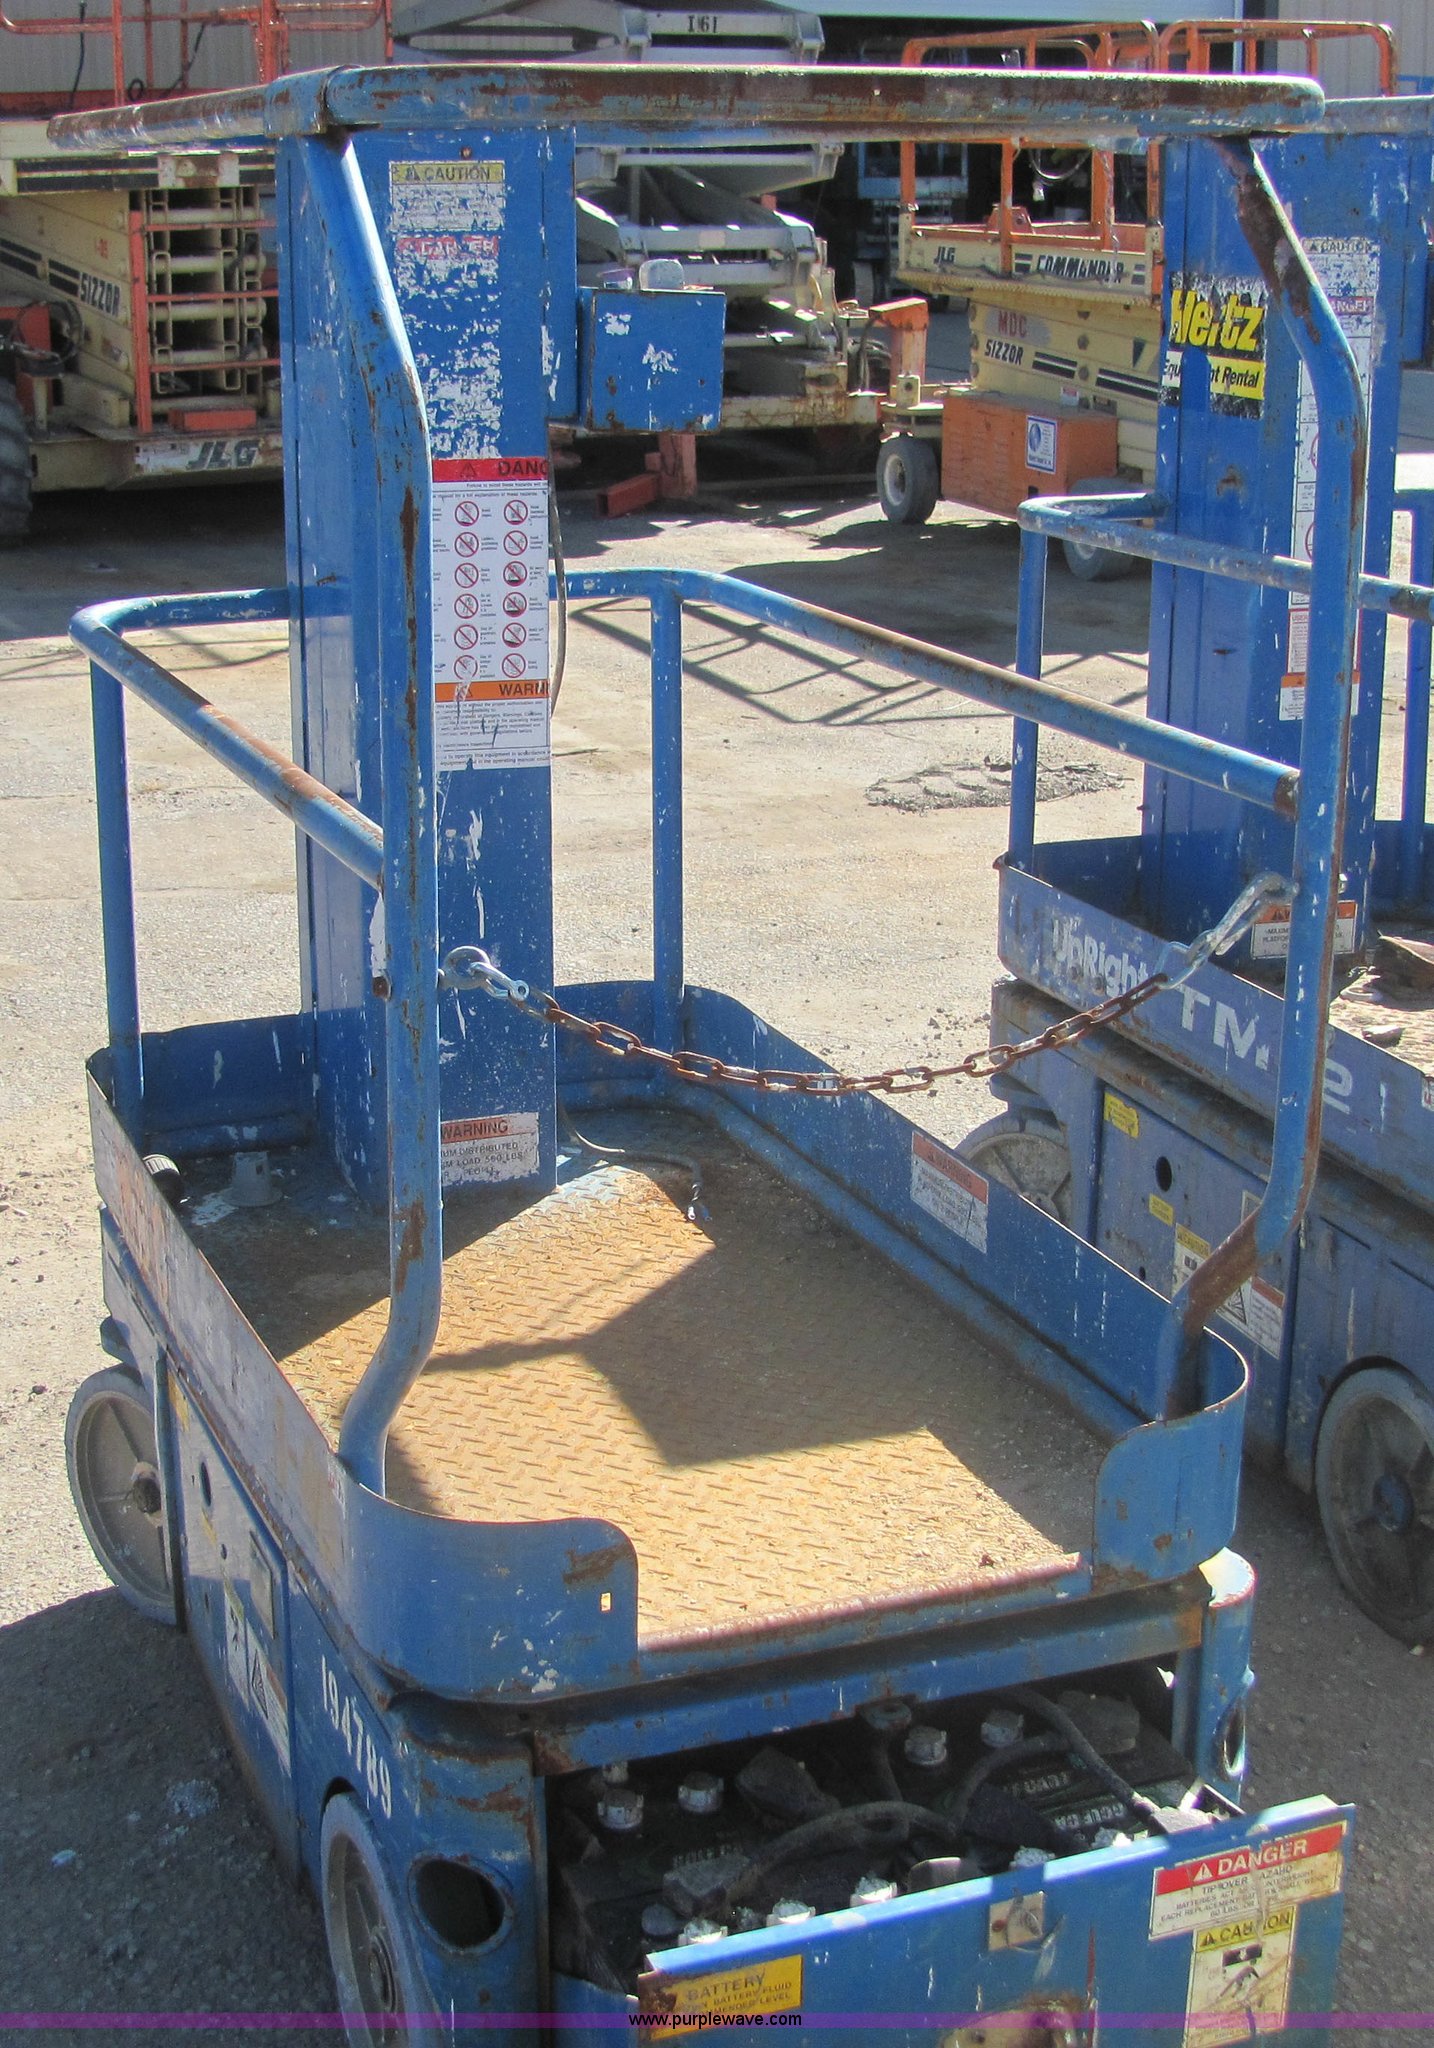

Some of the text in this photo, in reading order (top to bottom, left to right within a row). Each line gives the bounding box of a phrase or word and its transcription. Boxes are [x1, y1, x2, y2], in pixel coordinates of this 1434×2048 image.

[424, 166, 490, 181] CAUTION
[421, 240, 495, 255] DANER
[934, 247, 956, 265] JLG
[998, 309, 1028, 338] MDC
[984, 338, 1024, 366] SIZZOR
[1221, 366, 1260, 389] Rental
[186, 440, 261, 470] JLG
[442, 1119, 509, 1140] WARNING
[322, 1653, 392, 1819] 194789
[1217, 1839, 1308, 1875] DANGER
[1220, 1877, 1249, 1890] OVER
[1219, 1911, 1291, 1941] CAUION
[687, 1970, 765, 2001] BATTERY
[762, 1981, 792, 1995] FLUID
[759, 1992, 791, 2006] LEVEL
